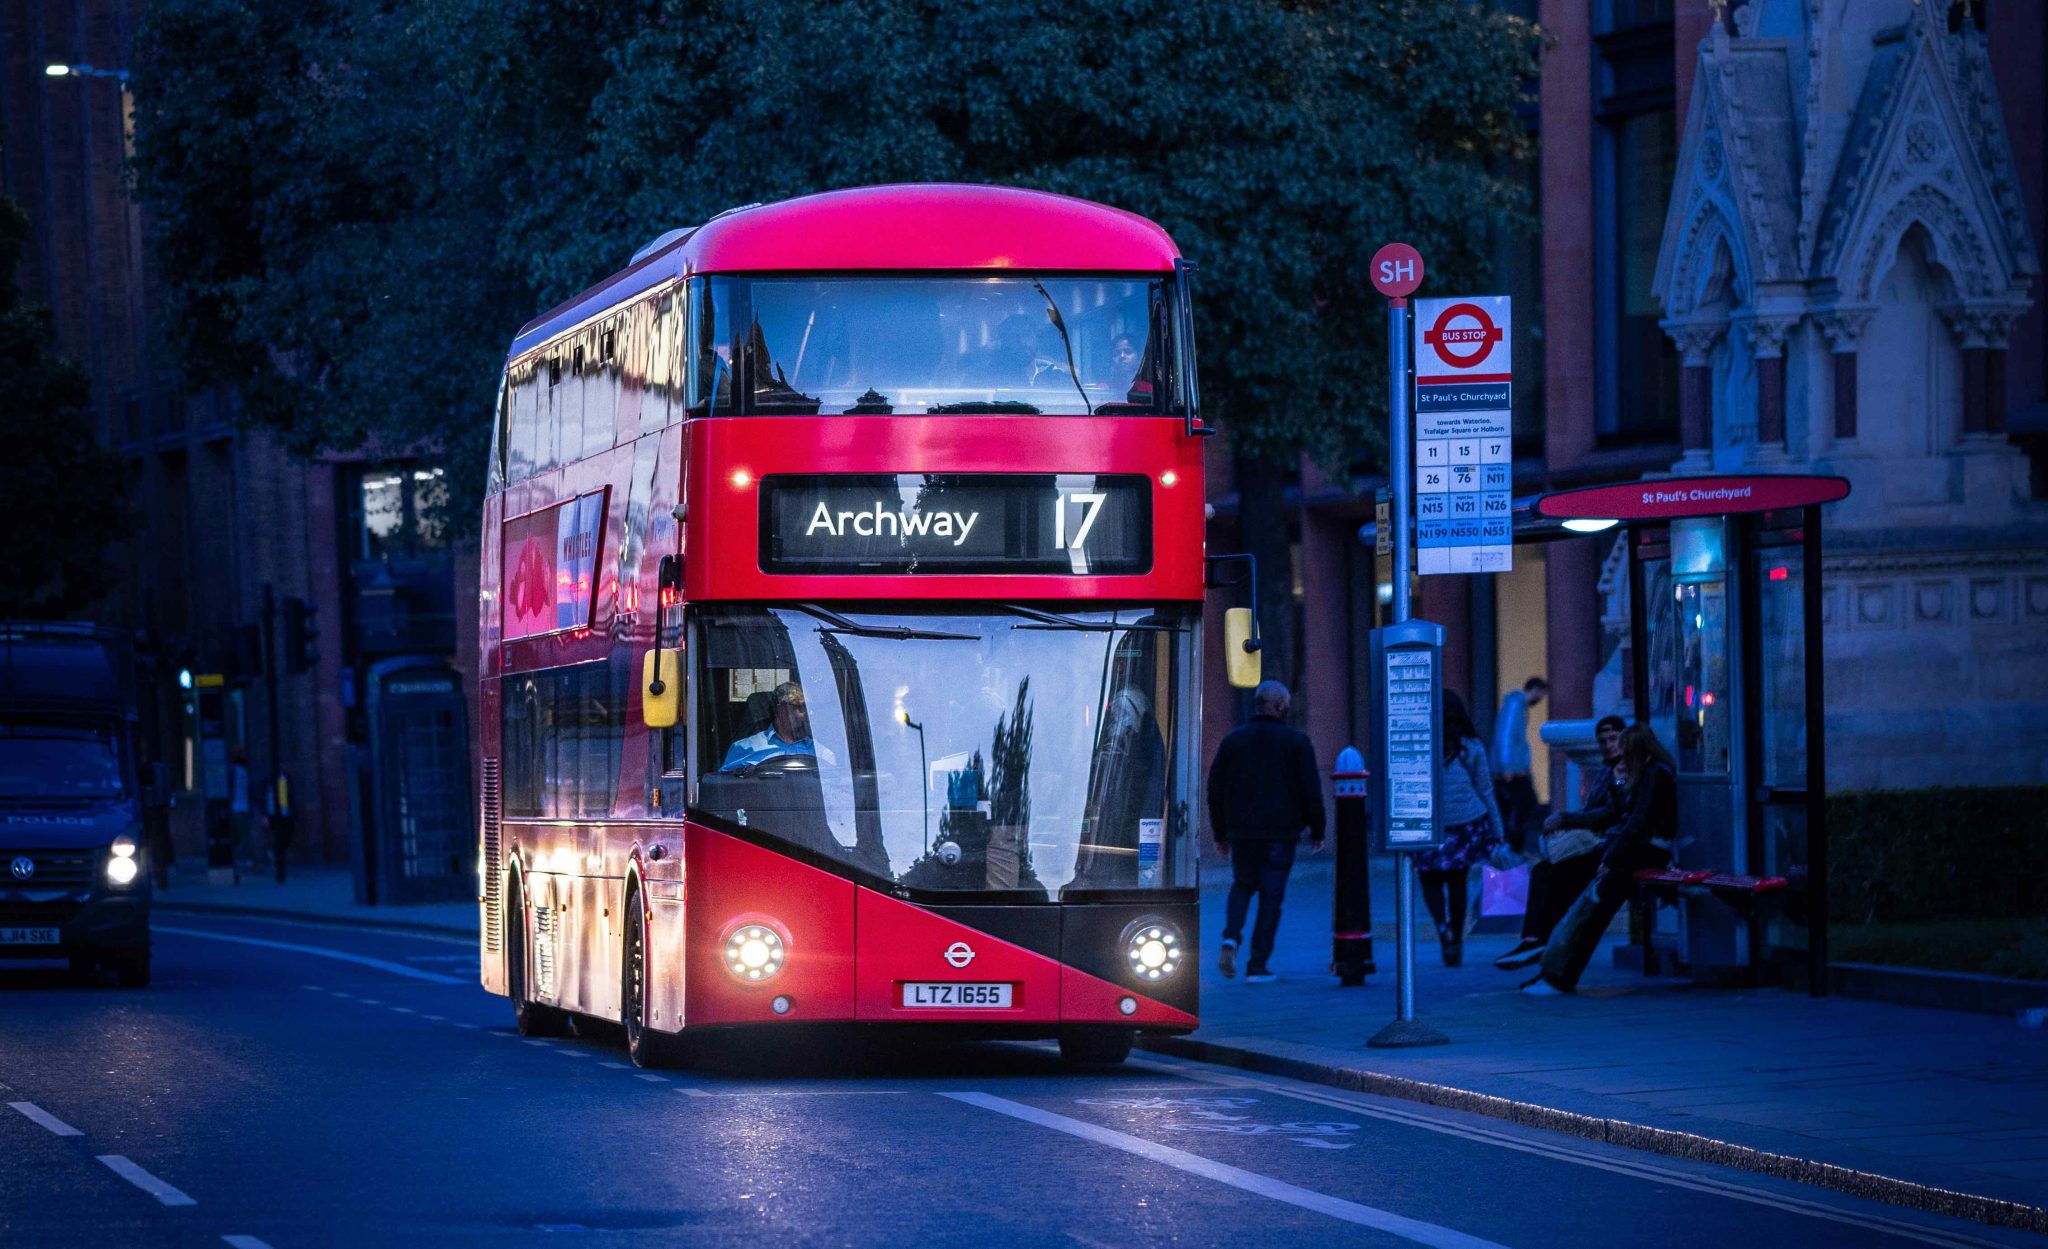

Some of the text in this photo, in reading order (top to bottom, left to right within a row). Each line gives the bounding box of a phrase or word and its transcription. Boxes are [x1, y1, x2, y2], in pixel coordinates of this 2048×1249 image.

[1380, 260, 1414, 283] SH
[1442, 331, 1487, 341] BUS STOP
[1421, 392, 1506, 402] St Paul's Churchyard
[1428, 447, 1437, 457] 11
[1459, 446, 1470, 456] 15
[1490, 445, 1501, 455] 17
[1426, 474, 1440, 485] 26
[1458, 473, 1471, 483] 76
[1487, 473, 1505, 484] N11
[1642, 486, 1751, 504] St Paul's Churchyard
[1422, 502, 1443, 513] N15
[1455, 502, 1475, 512] N21
[1485, 500, 1507, 511] N26
[806, 501, 979, 546] Archway
[1055, 493, 1107, 549] 17
[1419, 528, 1448, 539] N199
[1450, 527, 1479, 537] N550
[1483, 526, 1510, 537] N551
[8, 815, 94, 826] POLICE
[915, 986, 1000, 1003] LTZ 1655
